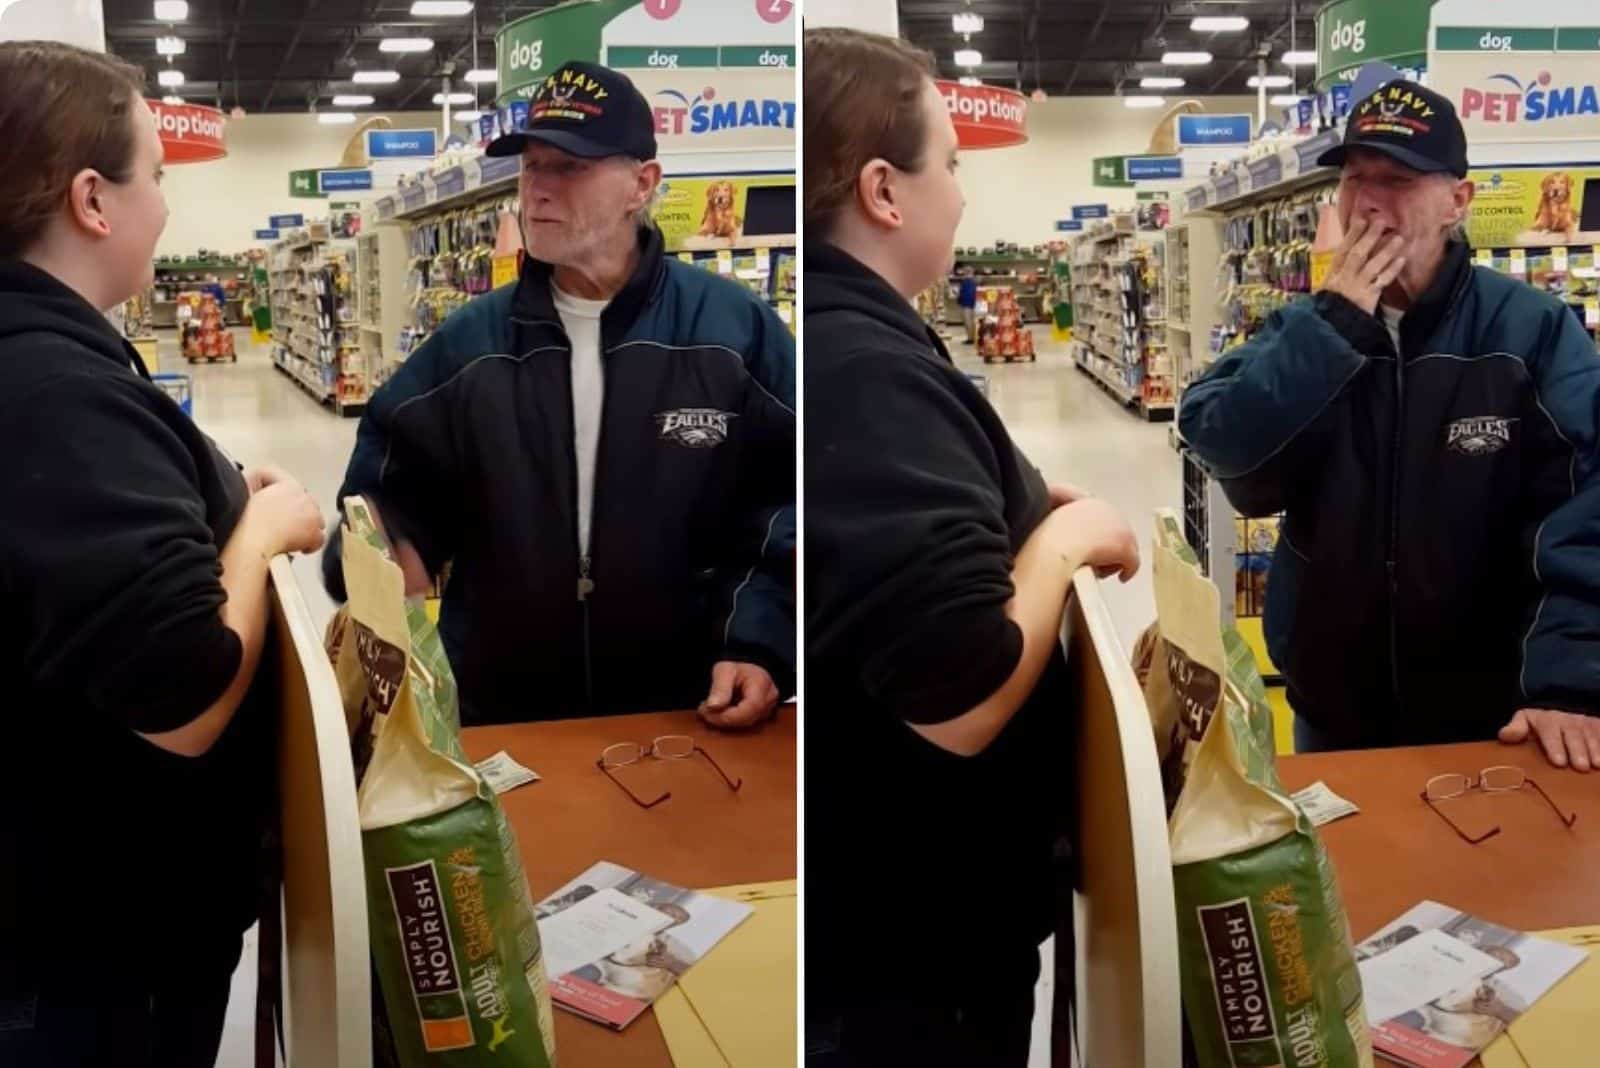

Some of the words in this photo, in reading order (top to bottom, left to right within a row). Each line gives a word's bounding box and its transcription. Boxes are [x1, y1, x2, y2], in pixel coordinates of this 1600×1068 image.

[1331, 18, 1366, 53] dog
[1479, 31, 1512, 52] dog
[510, 39, 543, 71] dog
[648, 50, 679, 69] dog
[758, 50, 788, 69] dog
[561, 69, 608, 99] NAVY
[653, 99, 796, 134] ETSMART
[1388, 87, 1434, 117] NAVY
[1461, 85, 1600, 122] PETSMA
[662, 412, 728, 437] EAGLES
[414, 877, 452, 987] NOURISH
[453, 870, 483, 960] CHICKEN
[407, 915, 430, 988] SIMPLY
[470, 963, 500, 1019] ADULT
[1227, 916, 1267, 1033] NOURISH
[1219, 956, 1244, 1034] SIMPLY
[1285, 1007, 1319, 1068] ADULT
